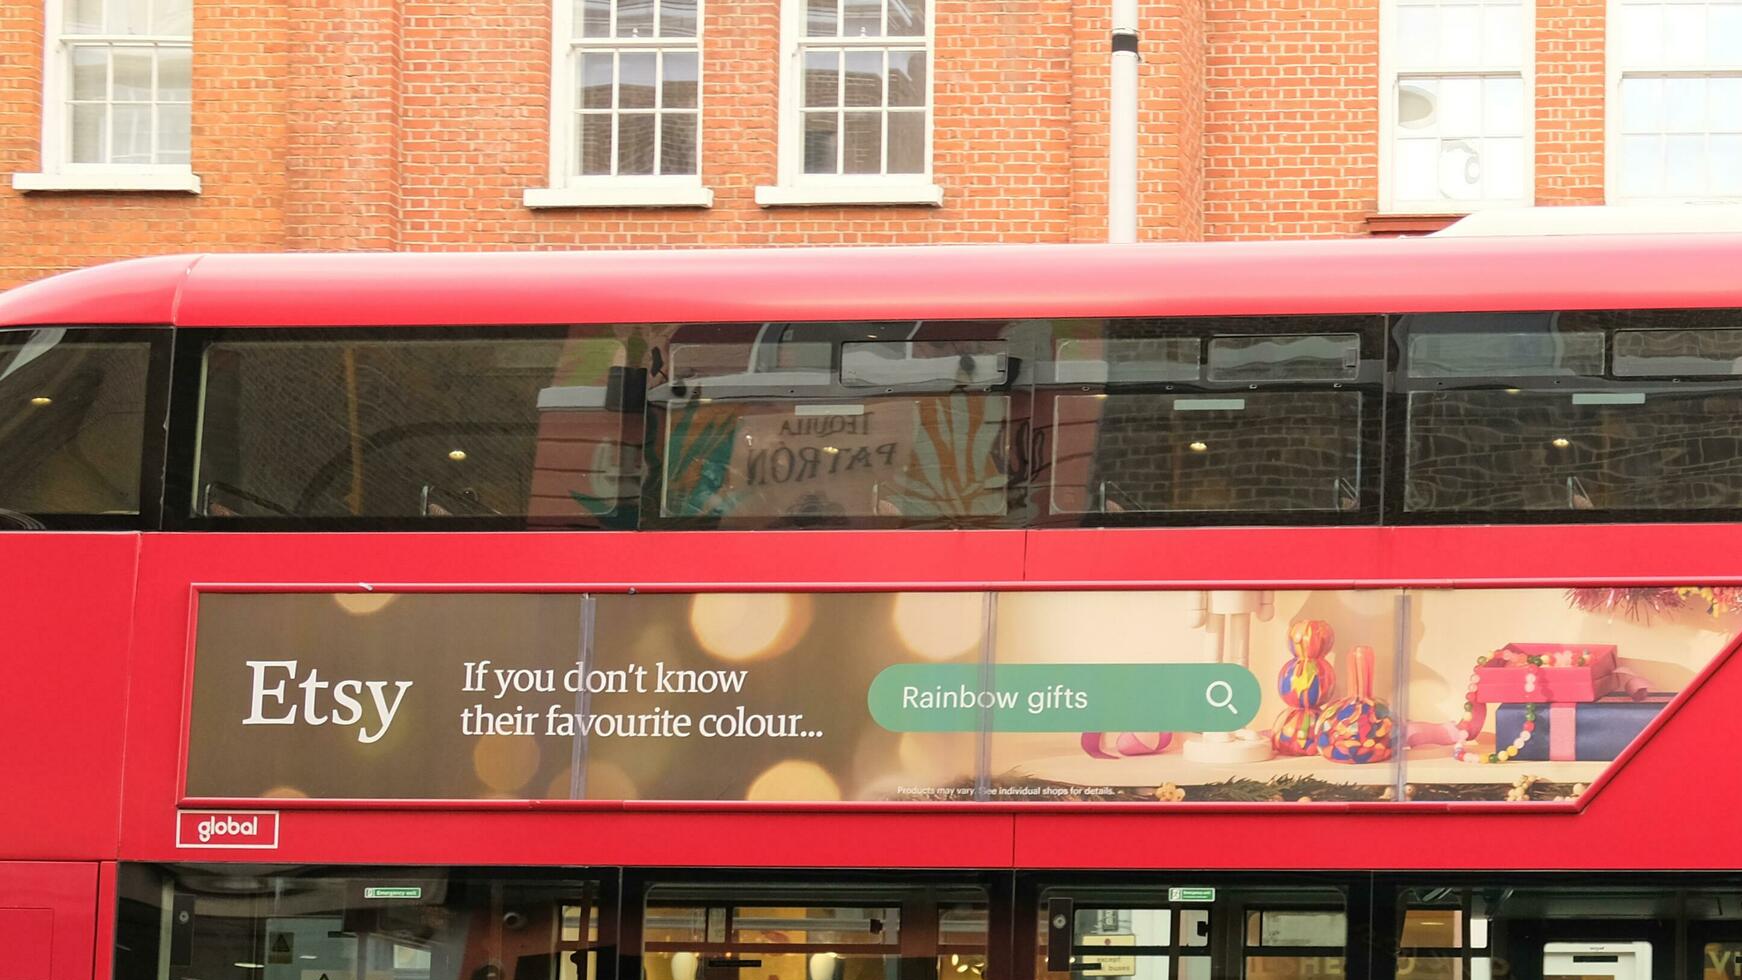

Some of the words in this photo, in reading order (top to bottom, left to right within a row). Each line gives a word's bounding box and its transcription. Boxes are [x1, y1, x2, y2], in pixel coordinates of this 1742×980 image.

[462, 660, 491, 692] If
[494, 668, 556, 699] you
[563, 661, 648, 693] don't
[654, 662, 748, 693] know
[242, 660, 413, 744] Etsy
[902, 684, 1019, 709] Rainbow
[1027, 684, 1088, 714] gifts
[460, 704, 539, 736] their
[545, 704, 692, 737] favourite
[699, 706, 823, 738] colour...
[897, 786, 935, 794] Products
[937, 787, 955, 796] may
[999, 786, 1041, 795] individual
[1042, 787, 1069, 796] shops
[1070, 787, 1082, 795] for
[1084, 786, 1115, 795] details.
[198, 815, 258, 843] global
